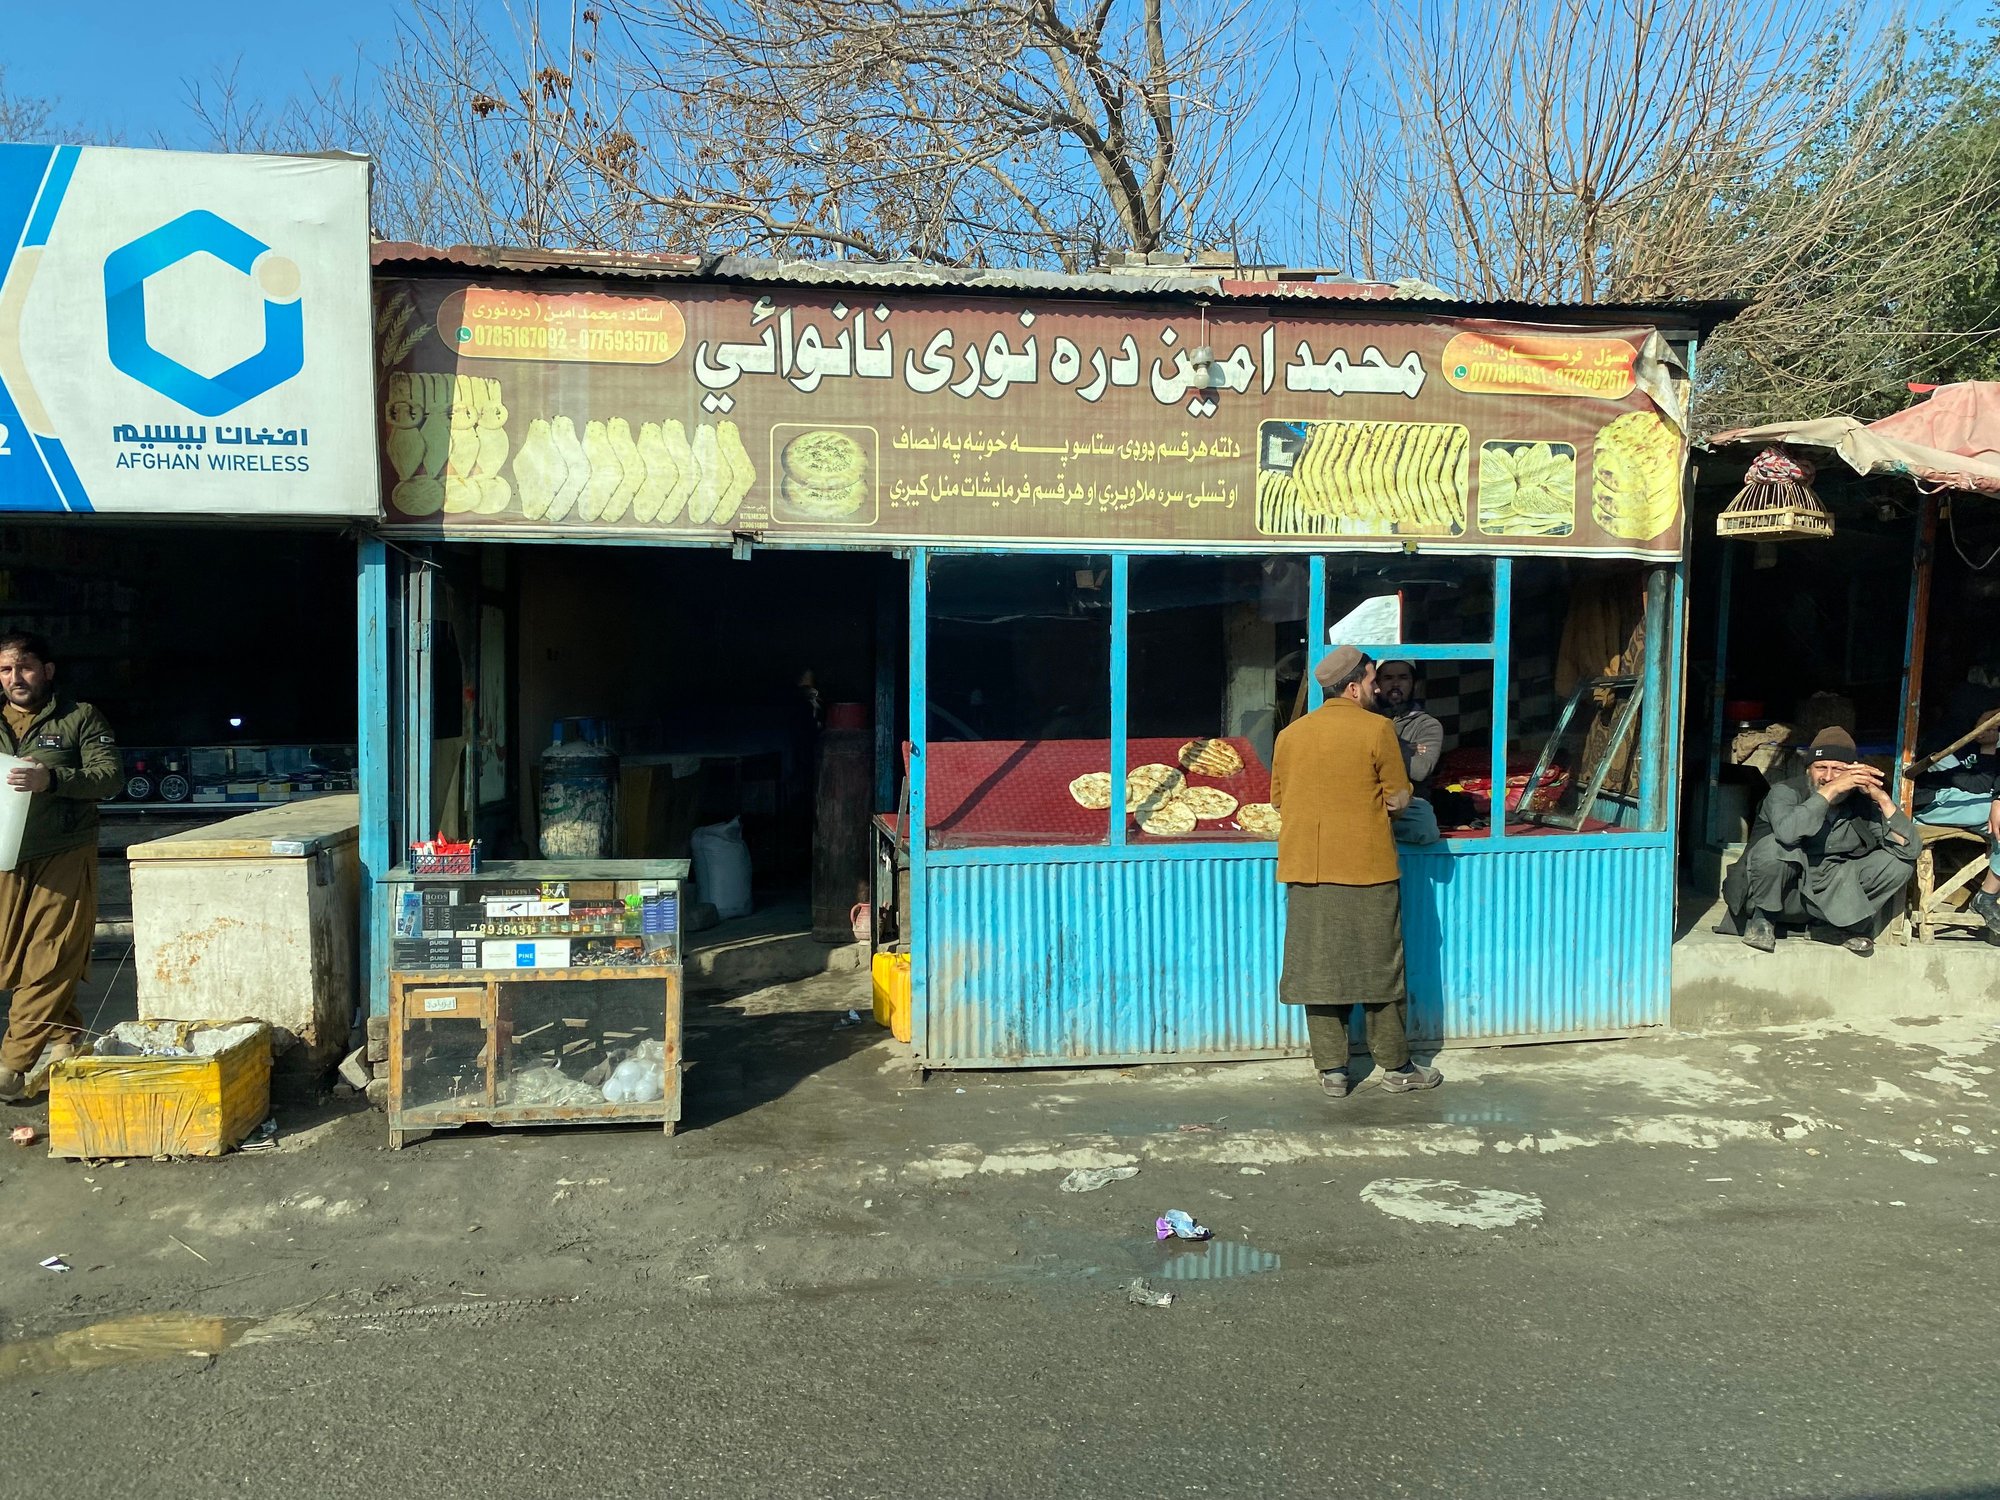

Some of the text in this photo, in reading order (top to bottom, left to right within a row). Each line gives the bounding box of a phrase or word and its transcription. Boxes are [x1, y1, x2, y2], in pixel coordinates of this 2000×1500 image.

[578, 306, 617, 321] محمد
[904, 308, 1039, 400] نوری
[1050, 333, 1140, 402] دره
[1284, 340, 1427, 399] محمد
[216, 426, 308, 446] افغان
[892, 424, 940, 450] انصاف
[1209, 435, 1241, 458] دلته
[116, 451, 309, 472] AFGHAN WIRELESS
